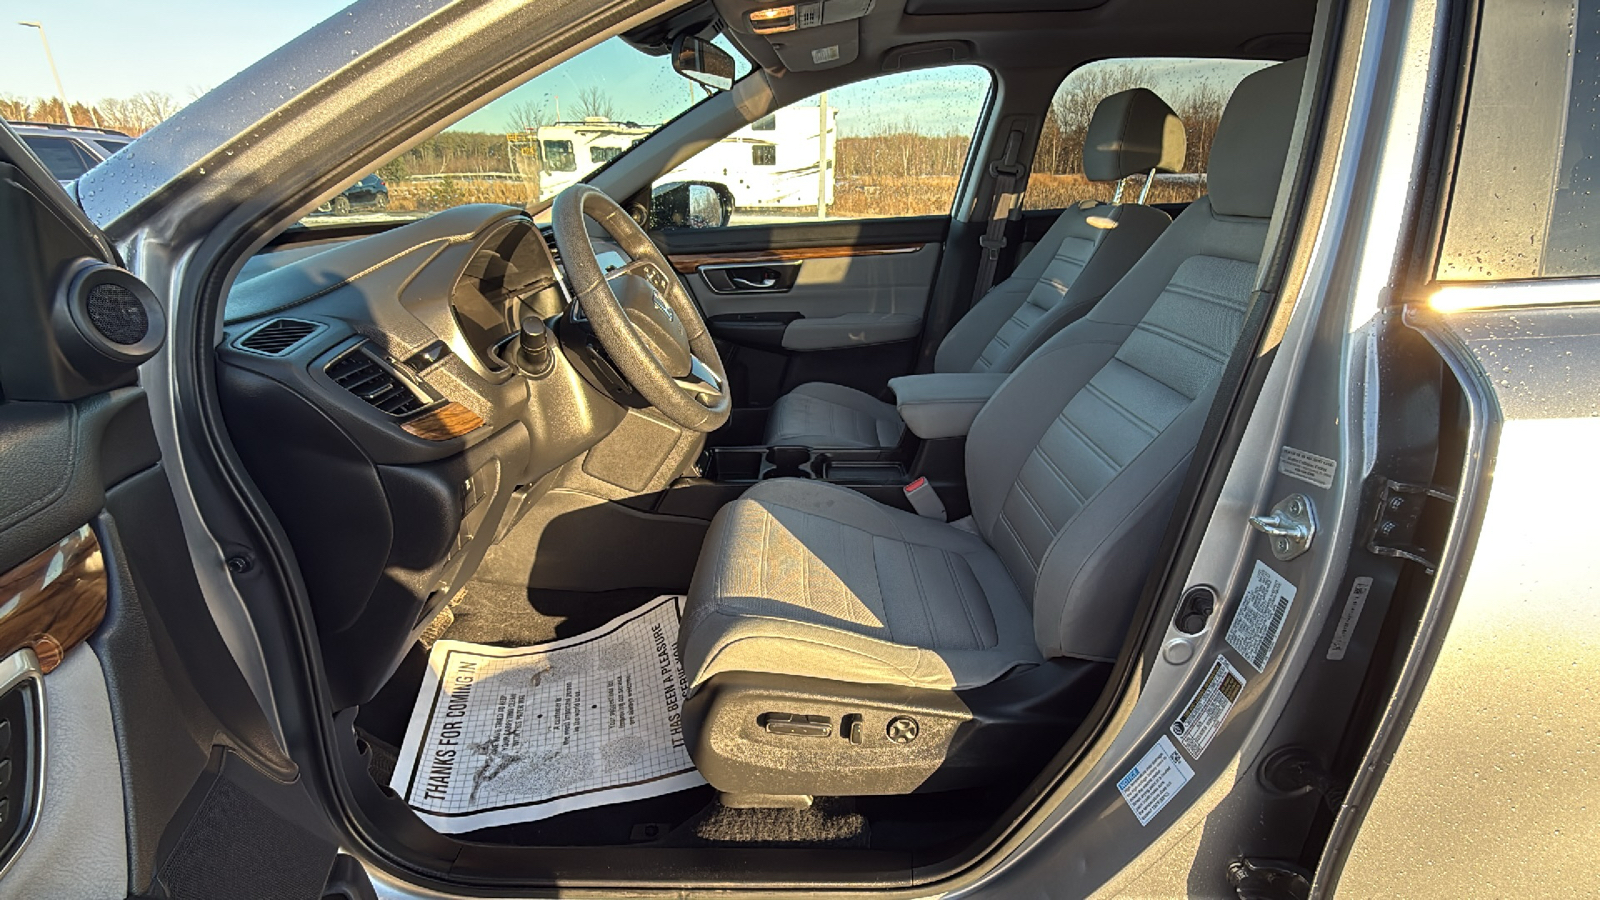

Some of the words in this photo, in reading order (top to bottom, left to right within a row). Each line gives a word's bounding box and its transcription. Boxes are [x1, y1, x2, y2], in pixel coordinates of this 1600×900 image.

[651, 623, 672, 675] PLEASURE
[458, 661, 477, 674] IN
[663, 674, 674, 683] A
[448, 676, 473, 718] COMING
[664, 684, 679, 712] BEEN
[438, 721, 462, 746] FOR
[668, 713, 682, 736] HAS
[672, 737, 685, 748] IT
[424, 749, 457, 801] THANKS
[1120, 769, 1137, 788] NOTICE
